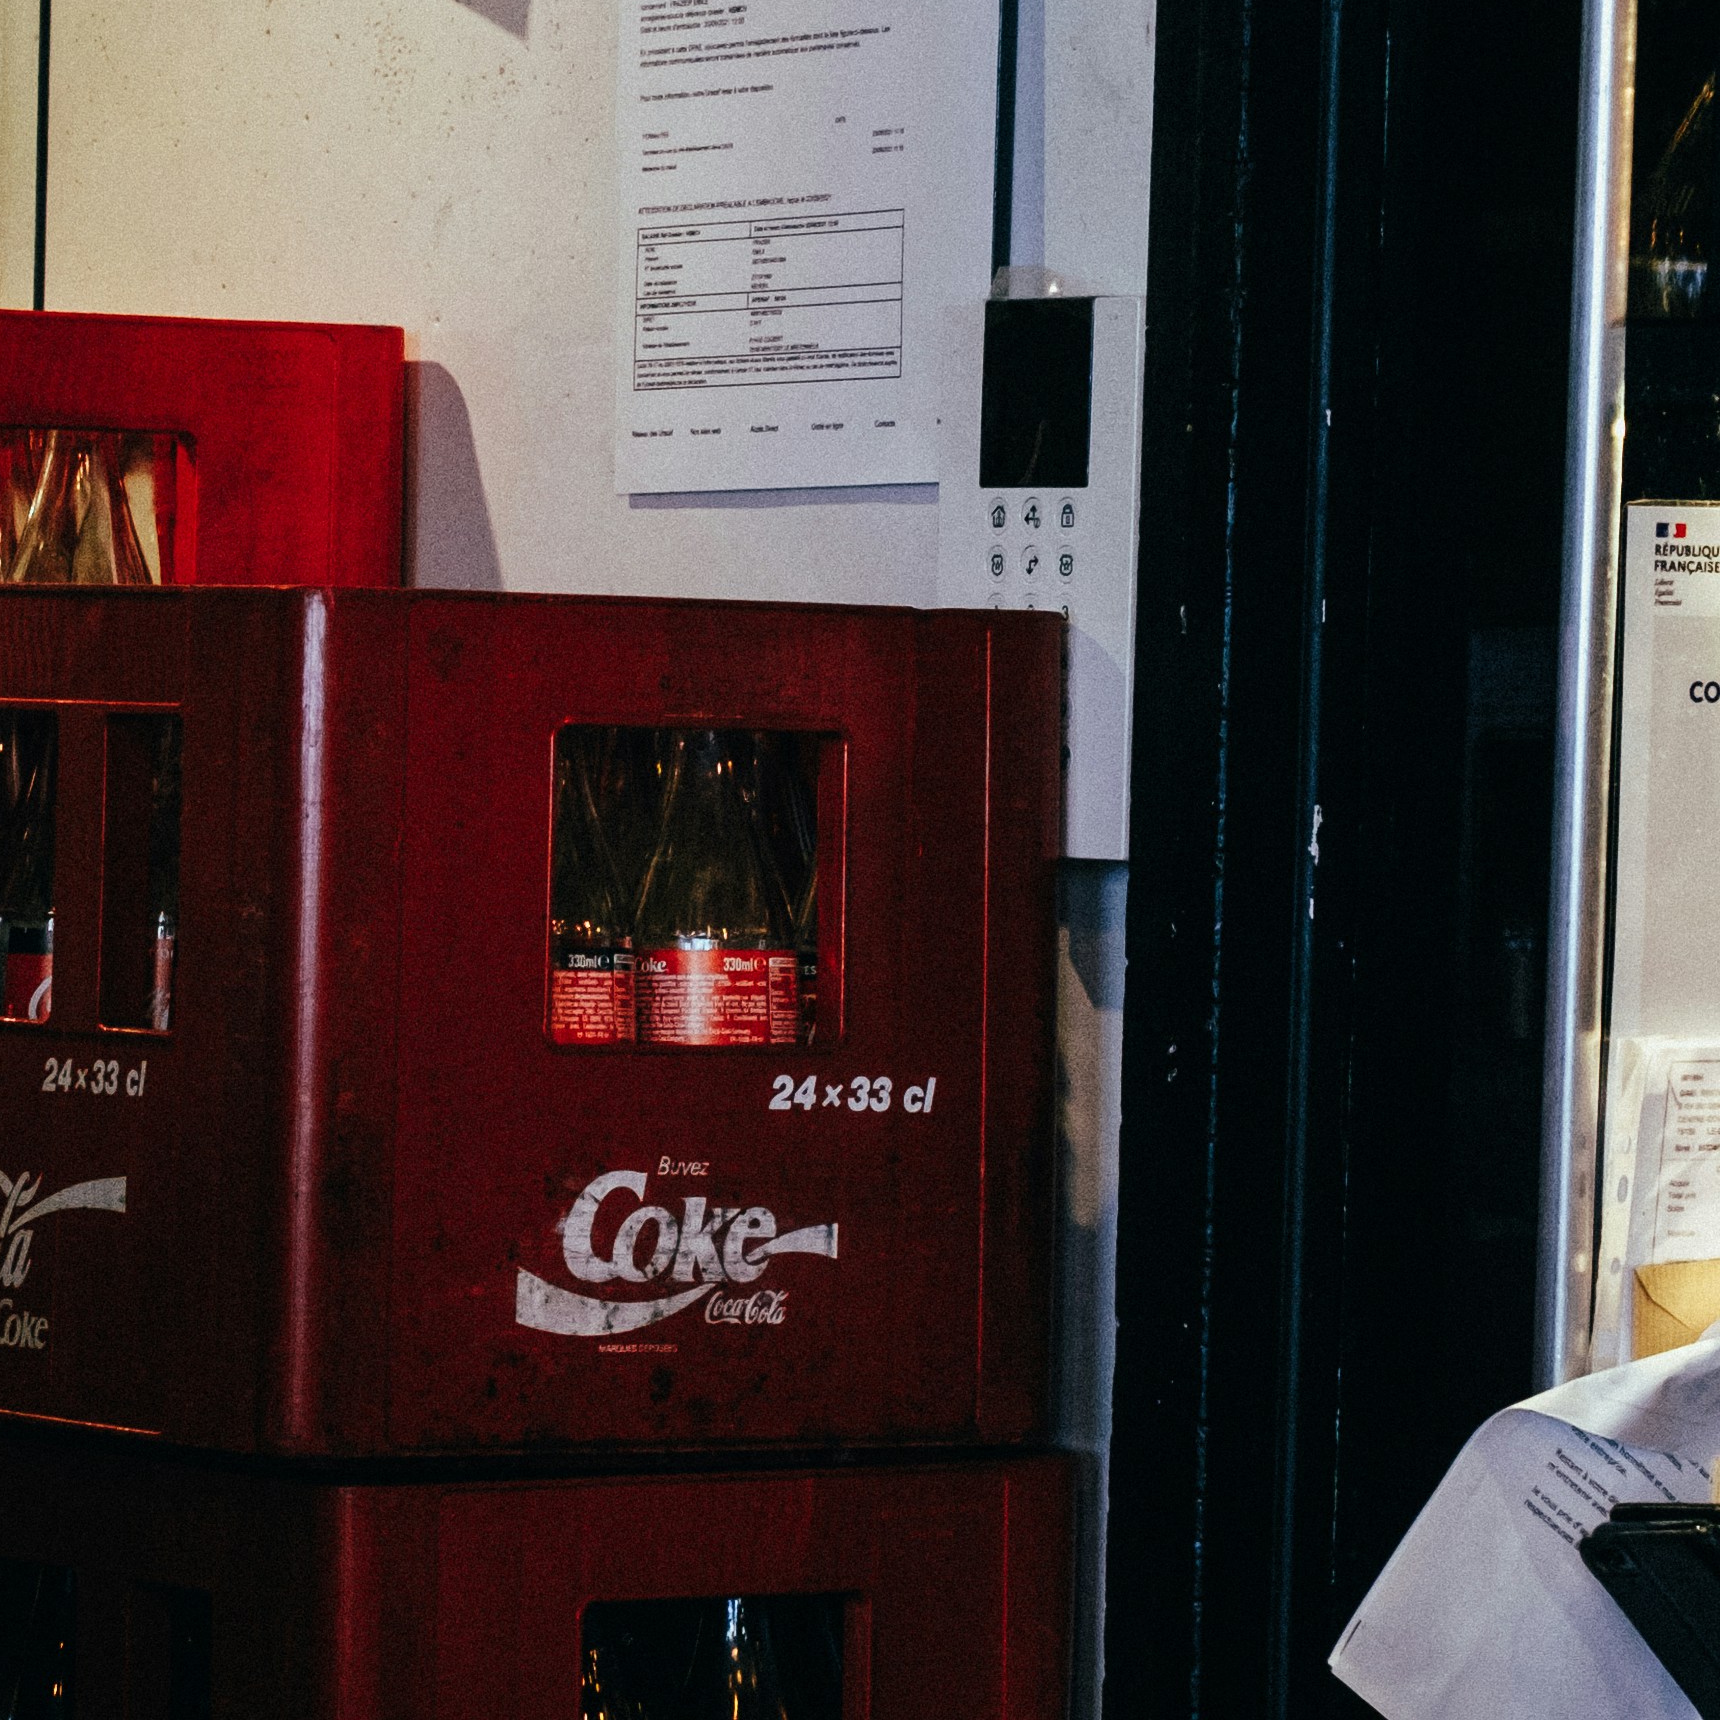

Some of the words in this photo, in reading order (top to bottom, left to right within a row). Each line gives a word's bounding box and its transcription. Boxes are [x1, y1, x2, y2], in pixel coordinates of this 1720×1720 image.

[634, 956, 667, 974] Coke
[125, 1059, 147, 1097] cl
[903, 1077, 937, 1114] cl
[658, 1155, 710, 1177] Buvez
[562, 1170, 780, 1283] Coke
[704, 1288, 787, 1326] Coca-Cola
